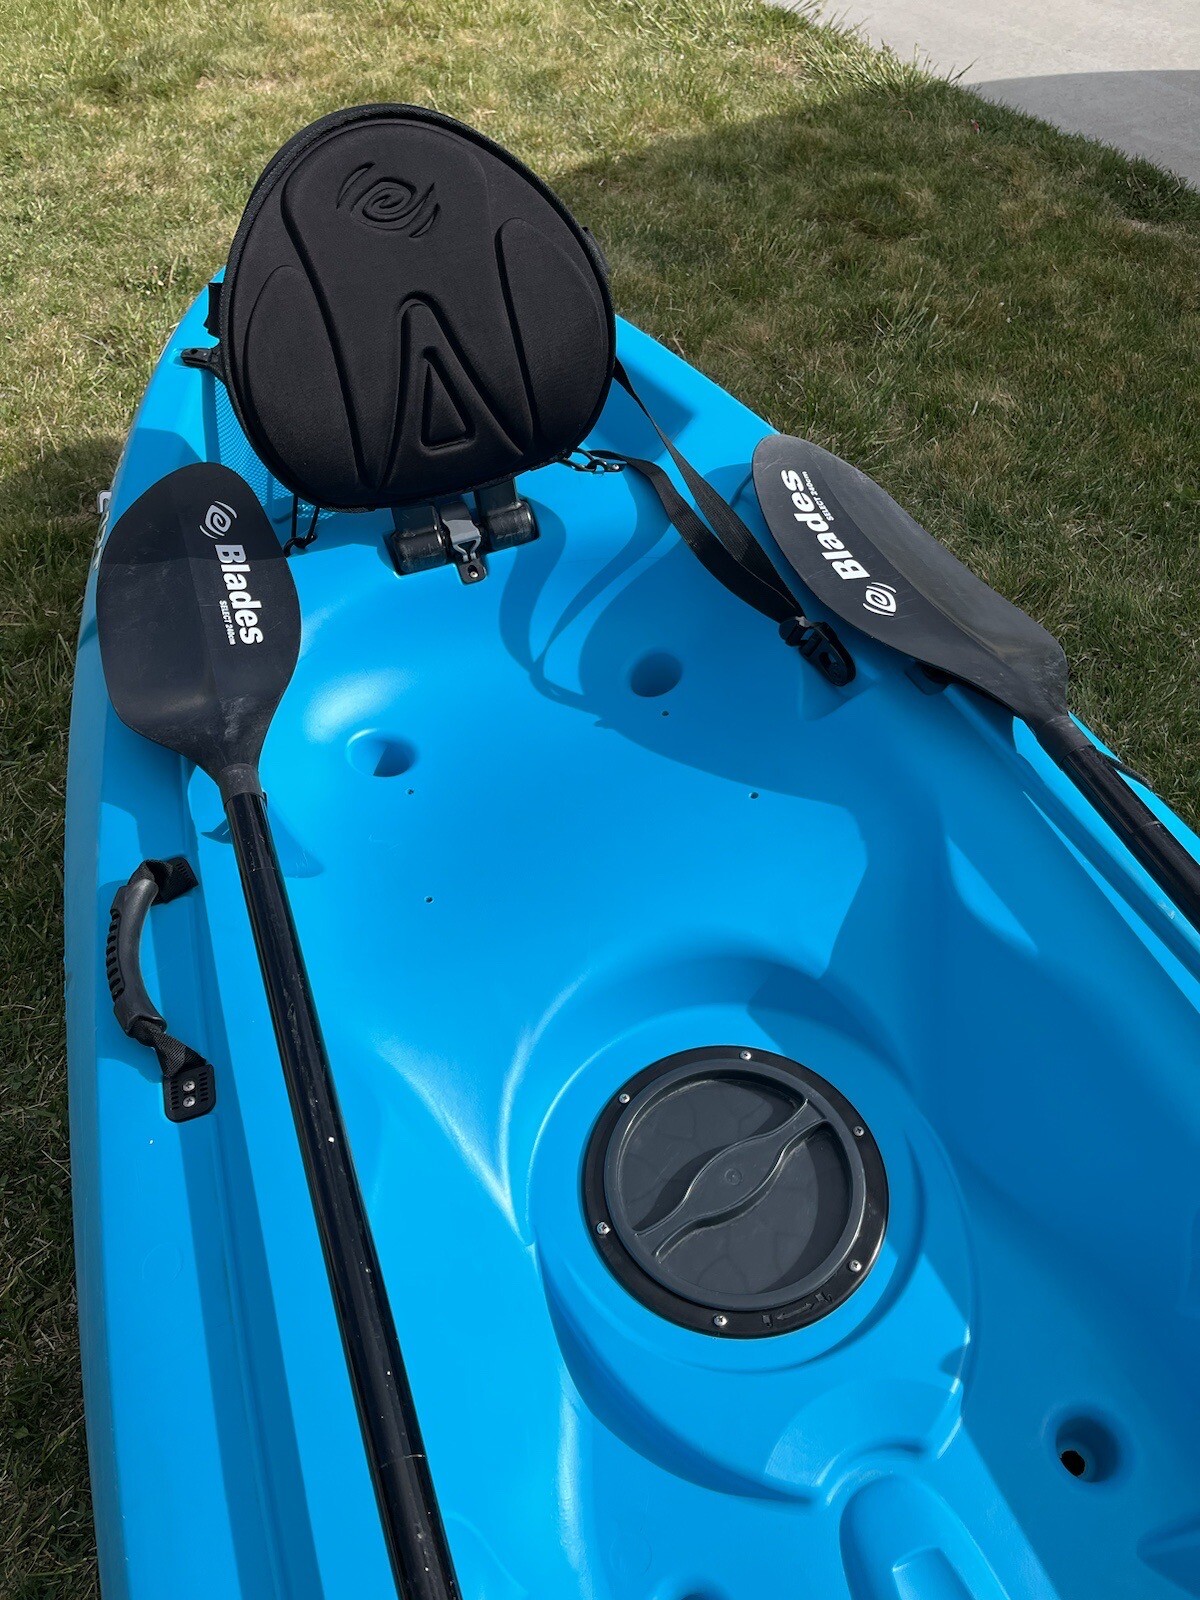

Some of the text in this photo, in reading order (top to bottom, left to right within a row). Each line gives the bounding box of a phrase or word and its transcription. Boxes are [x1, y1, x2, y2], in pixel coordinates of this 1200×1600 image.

[780, 469, 871, 580] Blades
[813, 496, 835, 521] SELECT
[214, 544, 264, 645] Blades
[219, 600, 233, 624] SELECT
